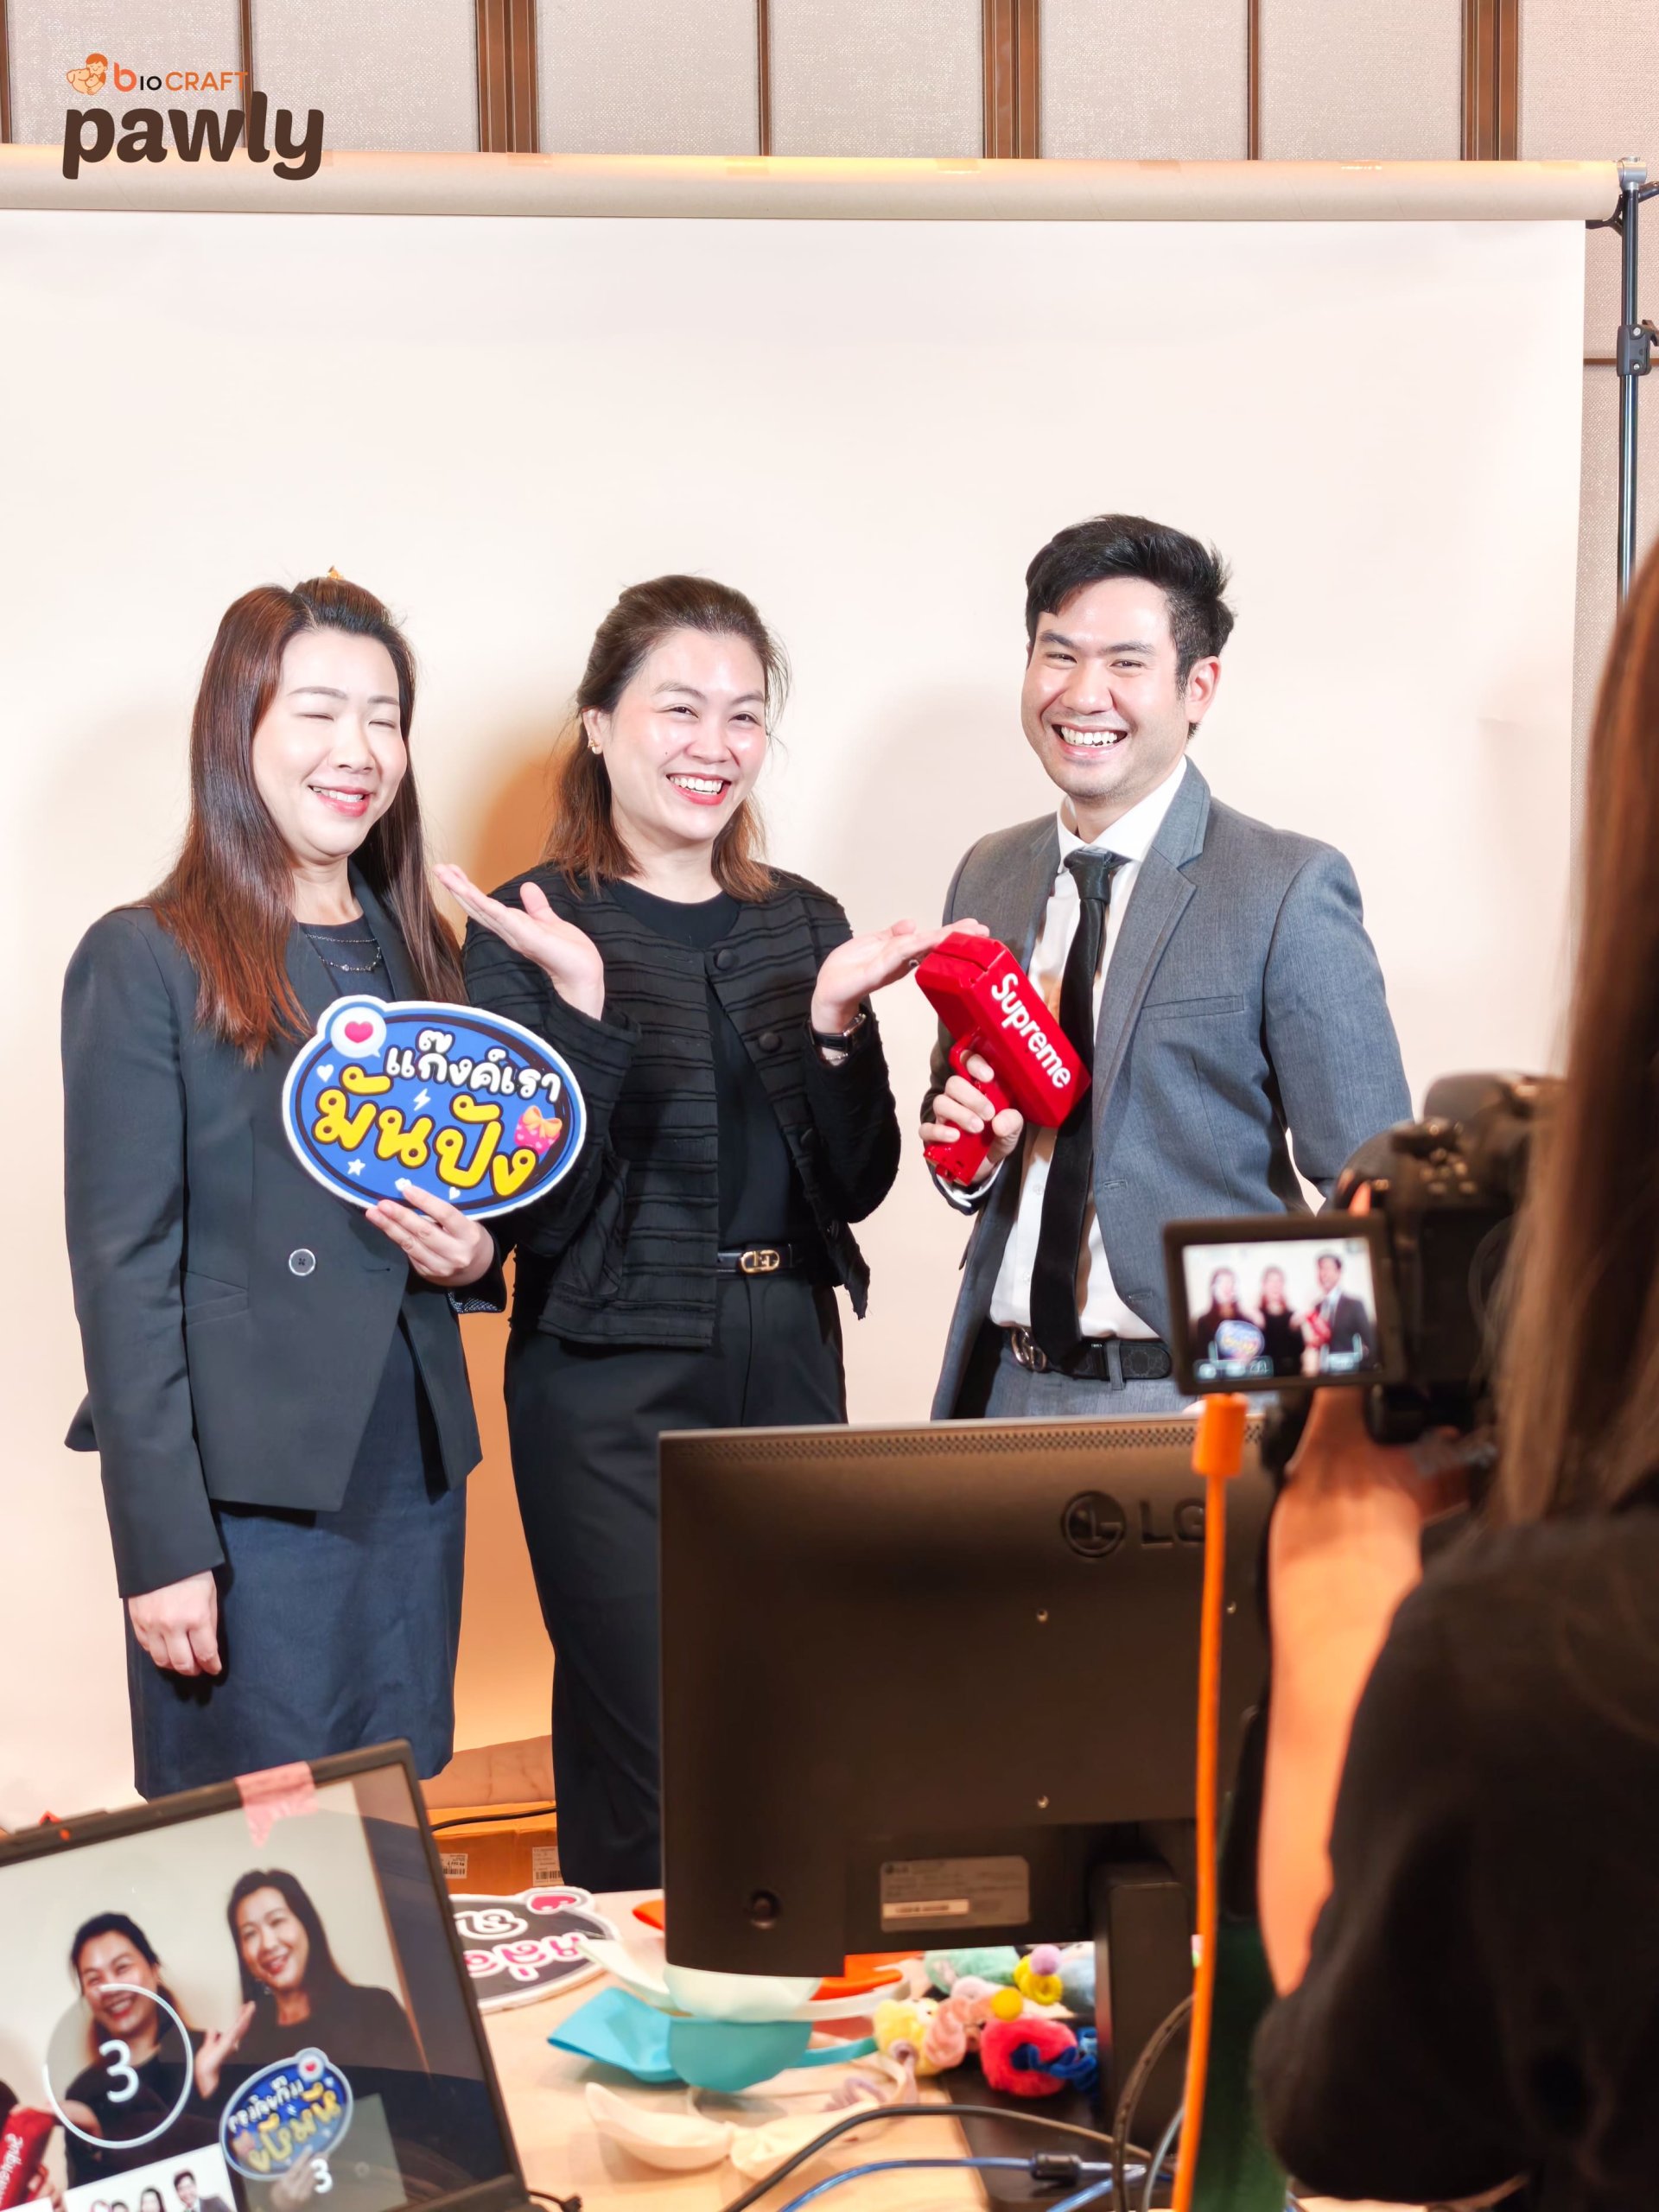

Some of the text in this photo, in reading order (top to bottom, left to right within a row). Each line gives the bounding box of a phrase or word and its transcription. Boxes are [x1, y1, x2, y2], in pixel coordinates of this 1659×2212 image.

[991, 973, 1071, 1089] Supreme
[385, 1029, 562, 1103] แก๊งค์เรา
[1139, 1499, 1206, 1546] LG
[99, 2038, 141, 2103] 3
[310, 2158, 334, 2194] 3
